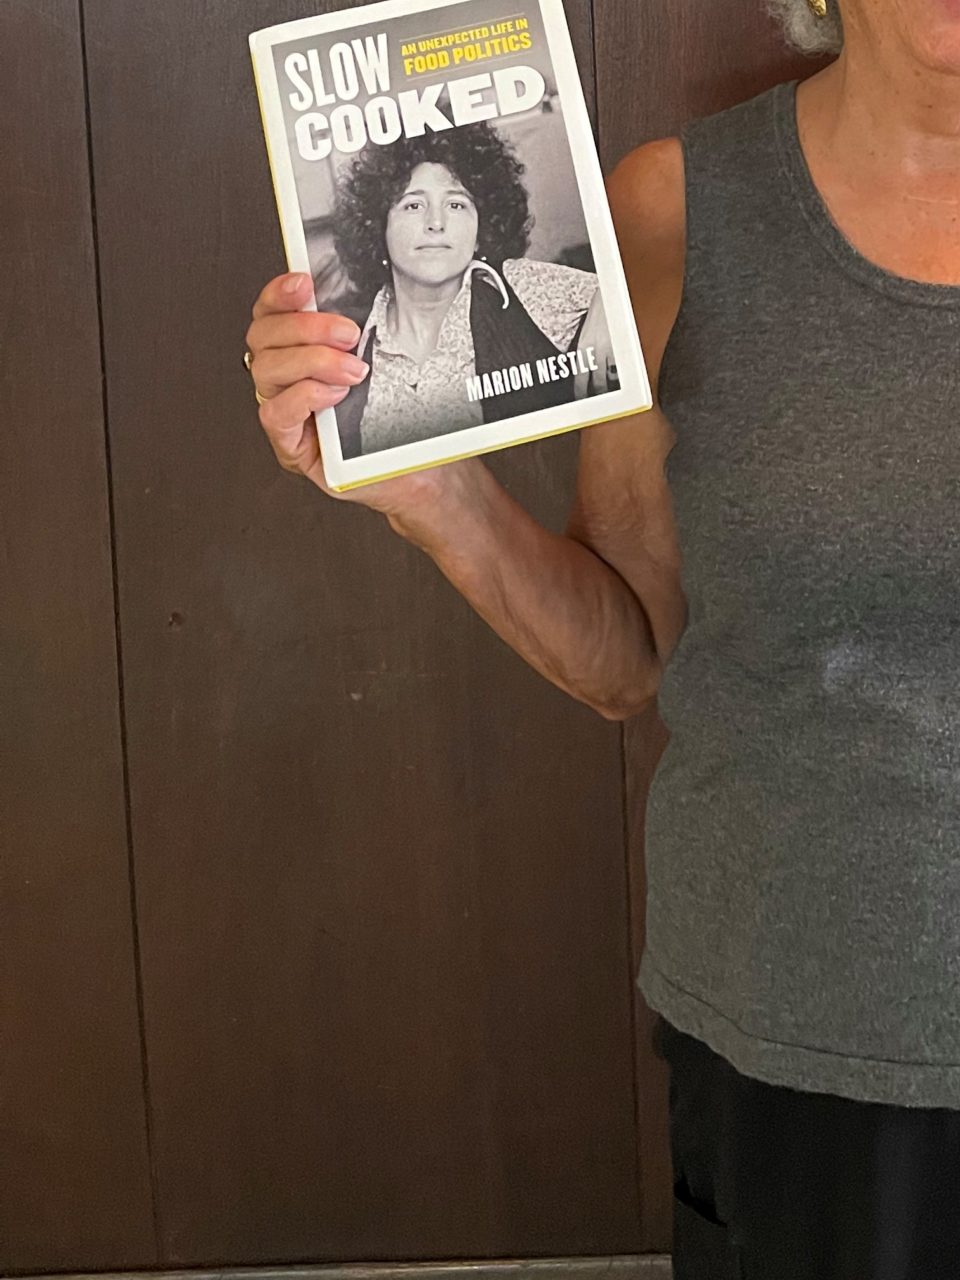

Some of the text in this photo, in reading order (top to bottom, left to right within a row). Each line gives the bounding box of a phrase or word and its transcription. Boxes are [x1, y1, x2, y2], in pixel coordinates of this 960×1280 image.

[402, 18, 528, 56] AN UNEXPECTED LIFE IN
[403, 32, 532, 76] FOOD POLITICS
[285, 32, 390, 111] SLOW
[294, 65, 545, 162] COOKED
[465, 346, 598, 402] MARION NESTLE
